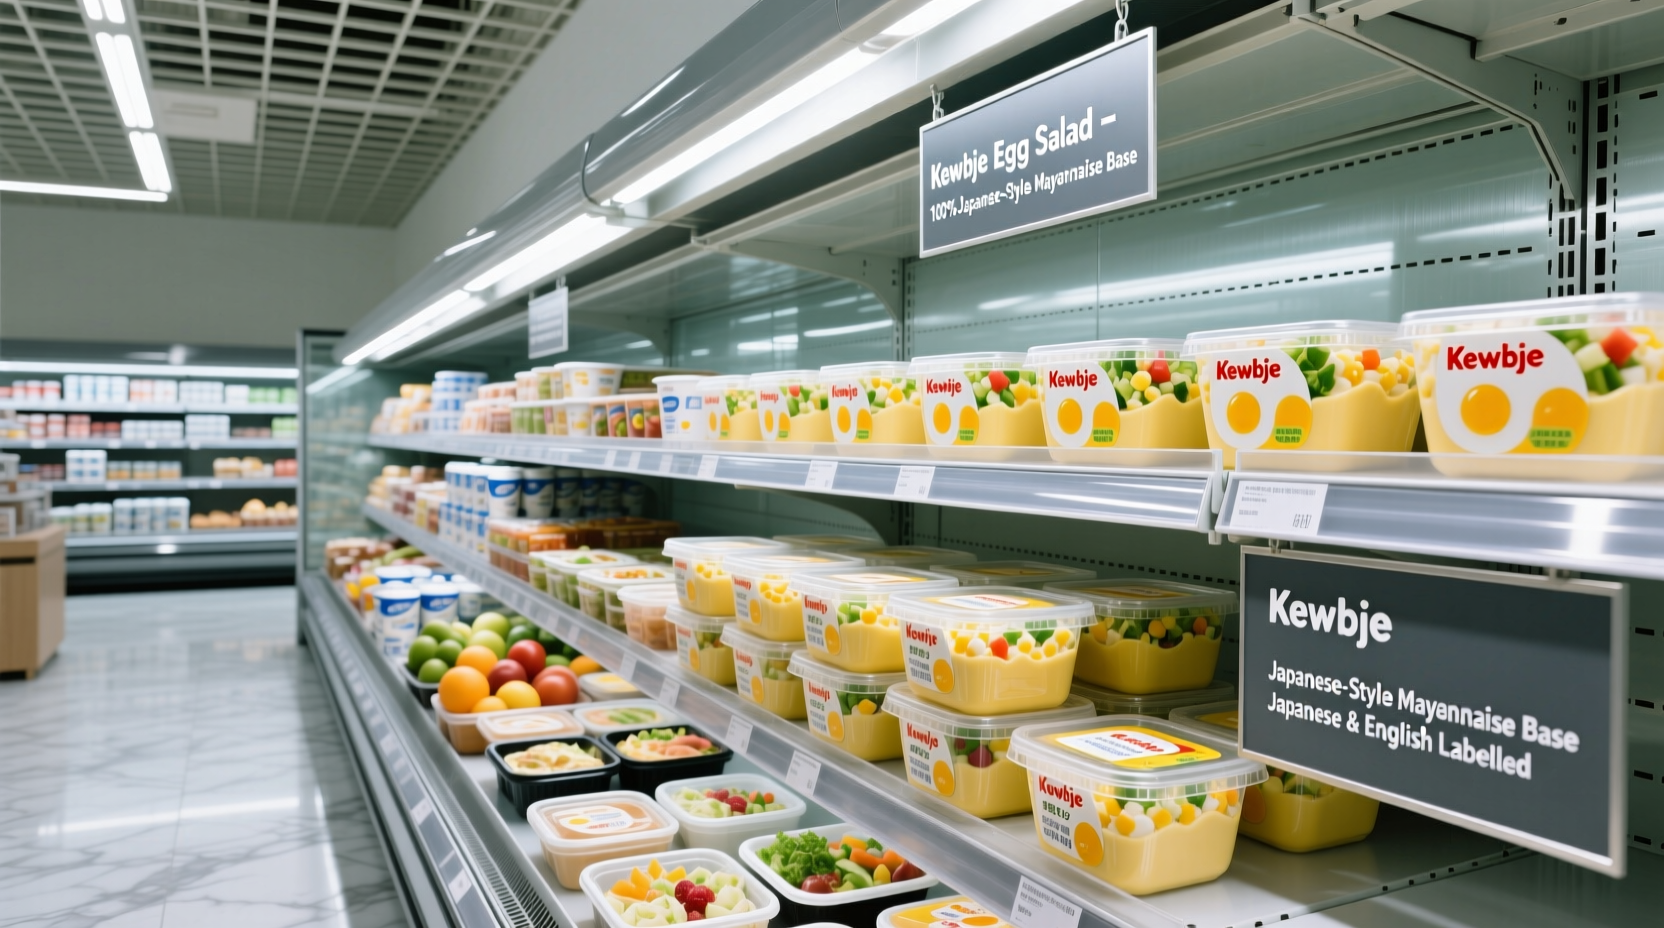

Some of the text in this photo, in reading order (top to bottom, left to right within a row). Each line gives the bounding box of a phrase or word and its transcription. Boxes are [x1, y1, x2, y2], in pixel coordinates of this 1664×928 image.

[931, 149, 988, 190] Kewbje
[994, 138, 1029, 173] Egg
[1035, 106, 1093, 156] Salad
[1107, 149, 1138, 172] Base
[1048, 369, 1098, 392] Kewbje
[1215, 357, 1282, 385] Kewbje
[1446, 341, 1545, 376] Kewbje
[1269, 588, 1393, 649] Kewbje
[1268, 660, 1394, 709] Japanese-Style
[1522, 715, 1580, 753] Base
[1268, 692, 1532, 780] Japanese & English Labelled
